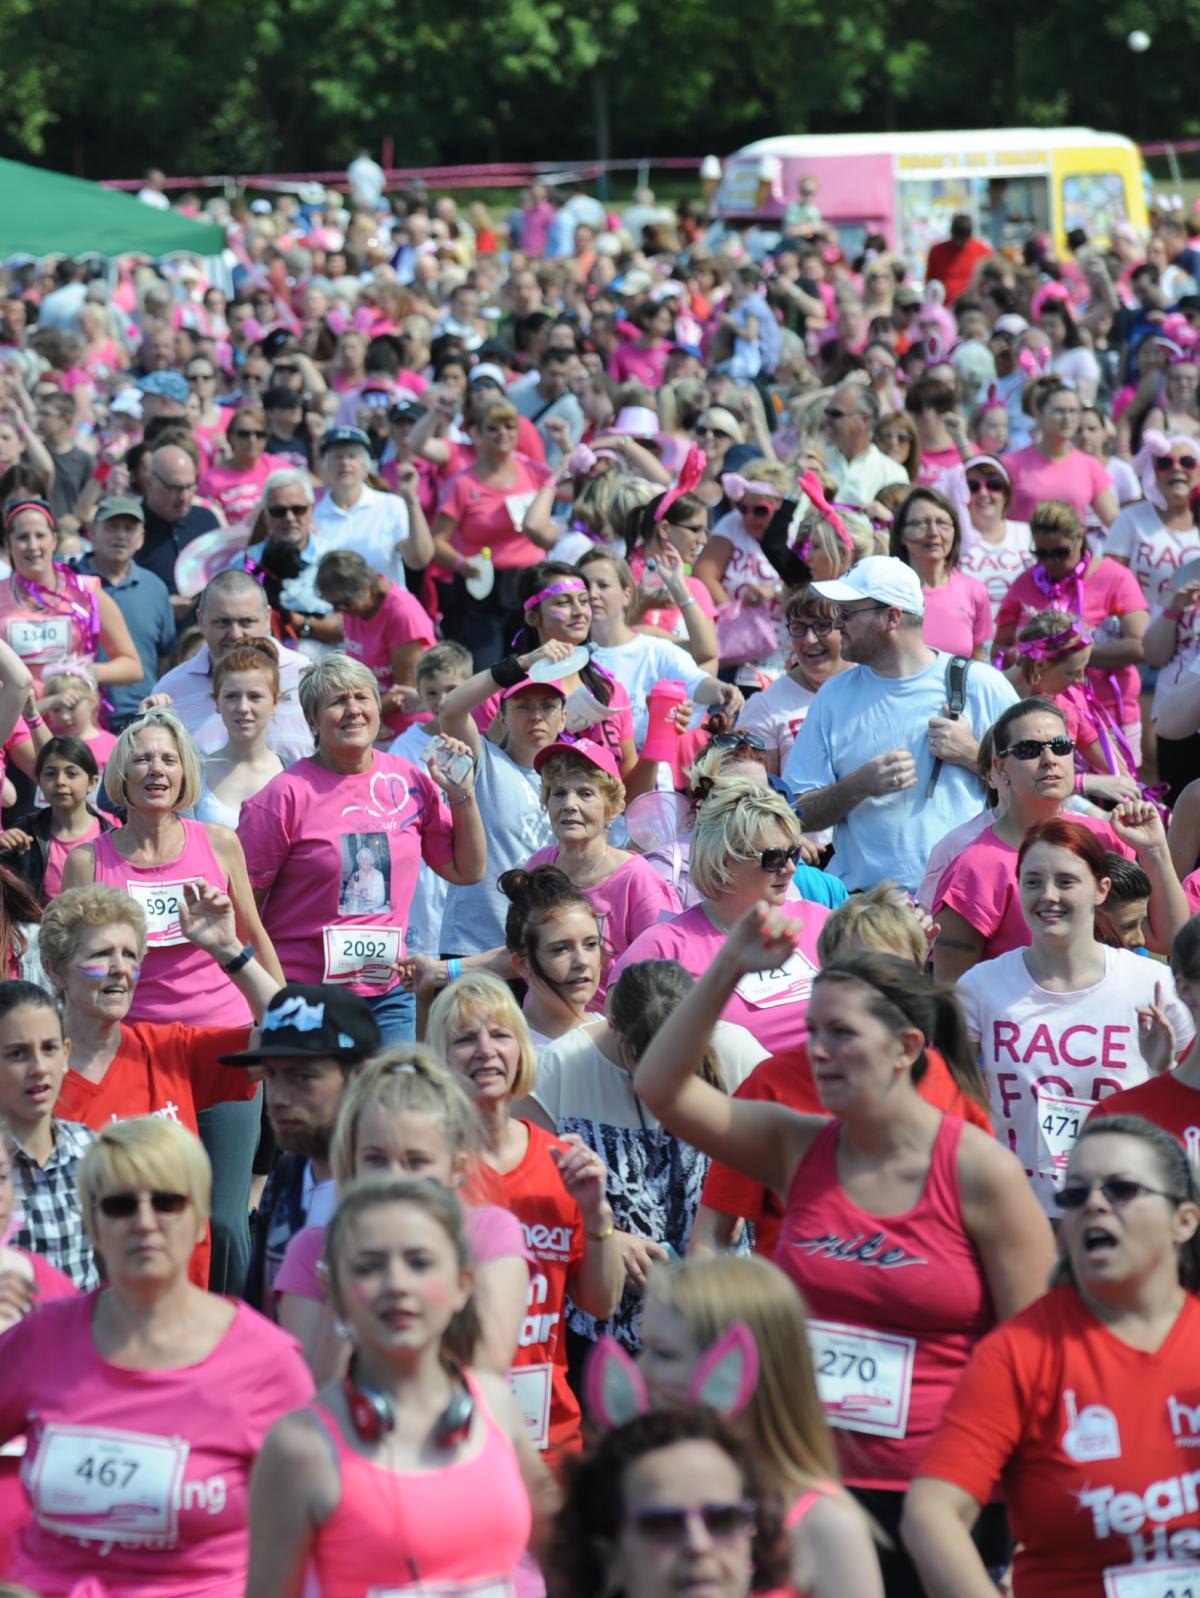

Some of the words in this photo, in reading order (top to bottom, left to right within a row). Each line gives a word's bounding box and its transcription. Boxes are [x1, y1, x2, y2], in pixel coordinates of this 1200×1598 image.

[146, 897, 179, 916] 592
[342, 940, 386, 958] 2092
[993, 1020, 1132, 1070] RACE
[1042, 1114, 1080, 1140] 471
[817, 1349, 877, 1383] 270
[75, 1456, 140, 1489] 467
